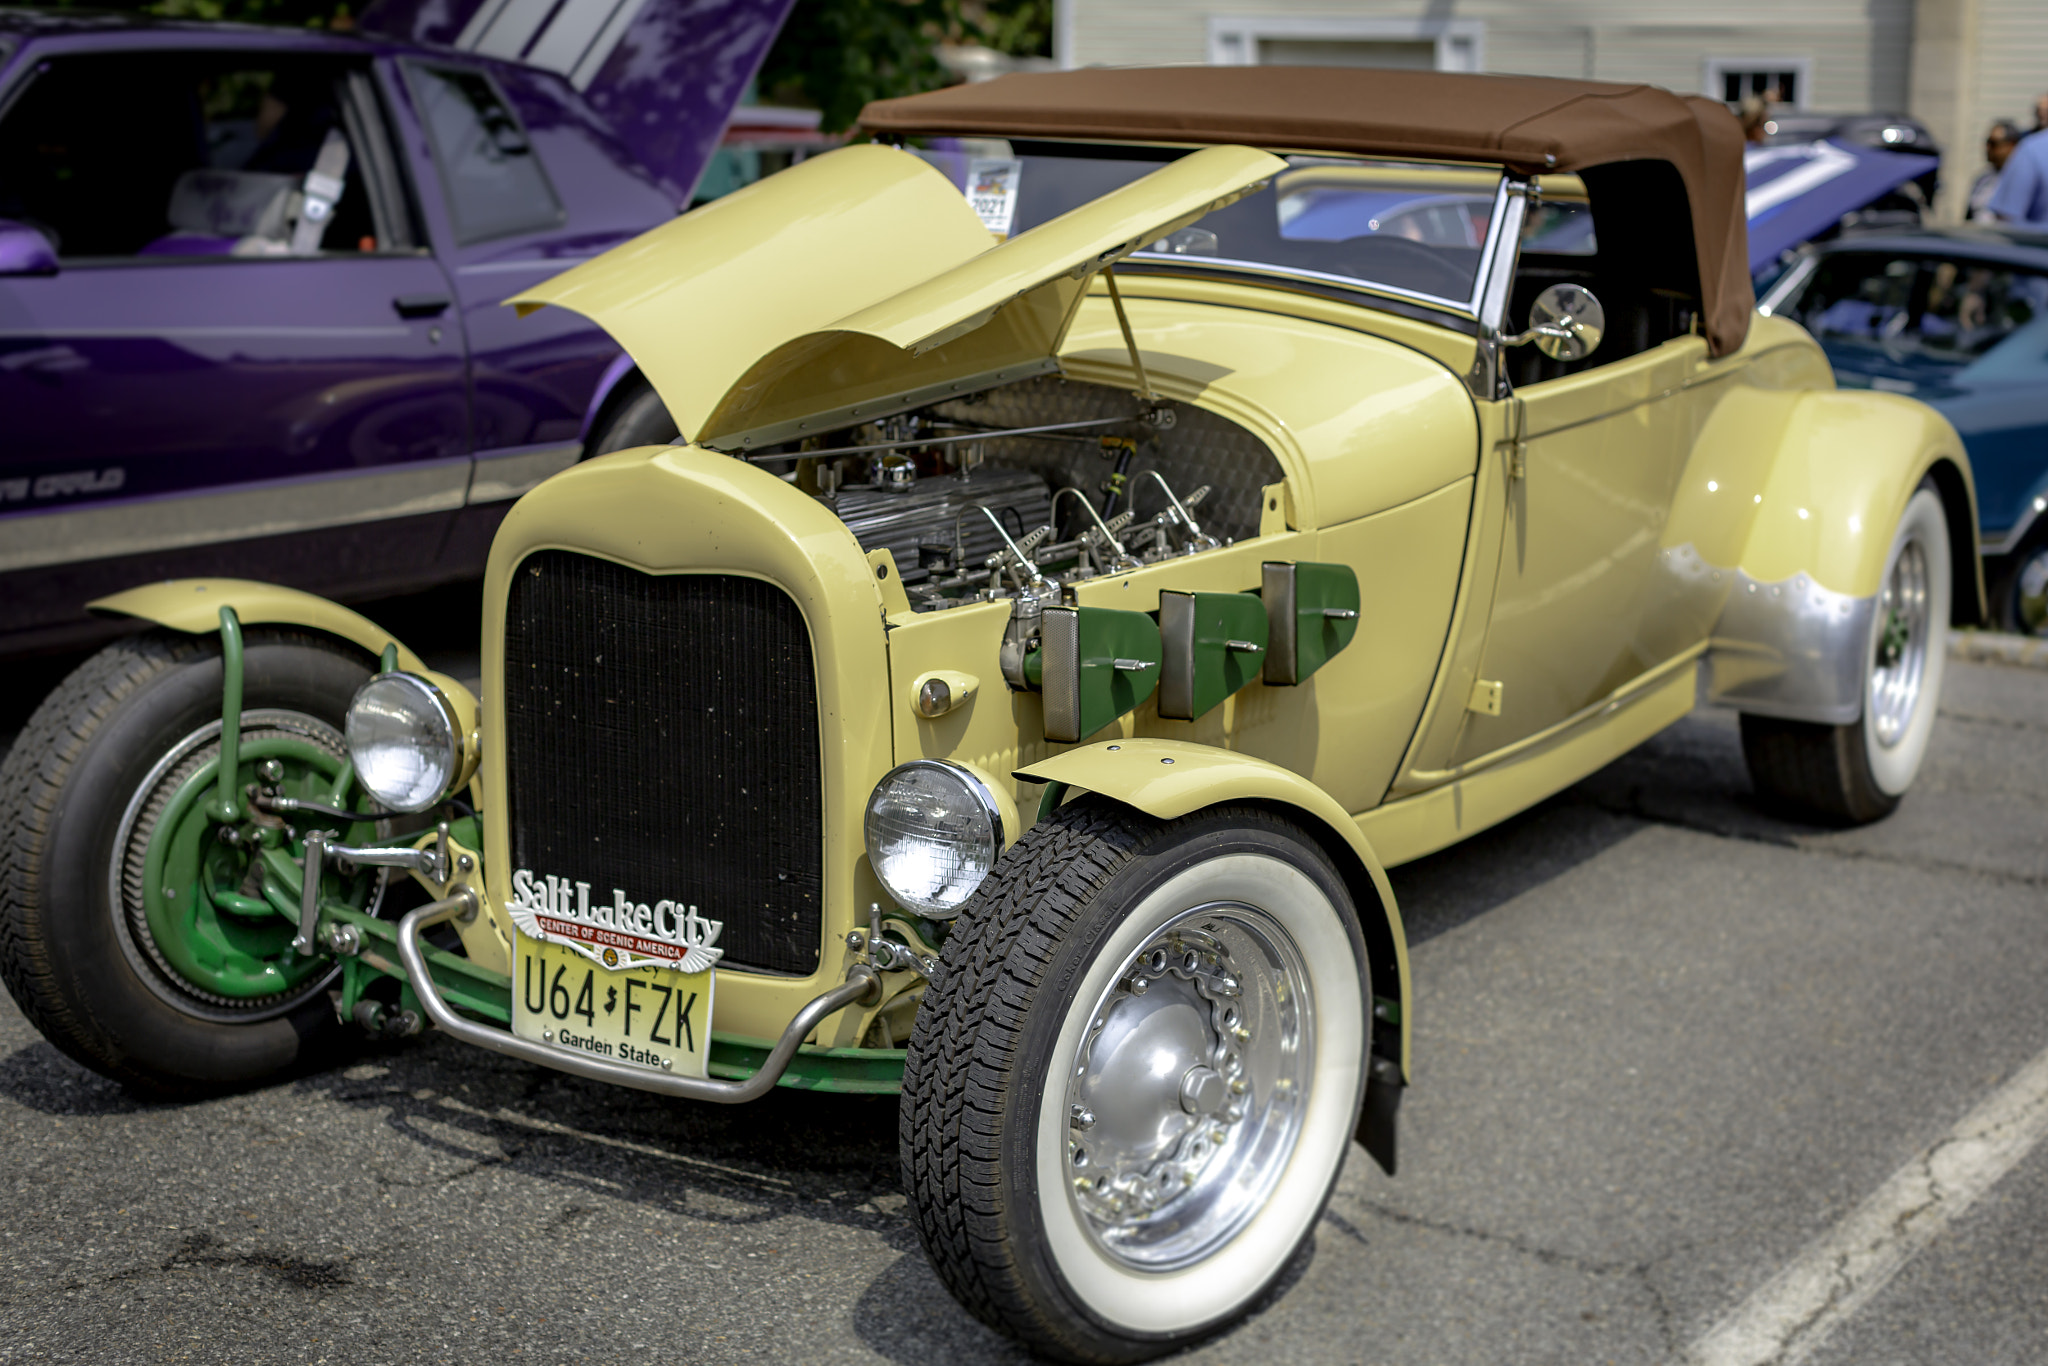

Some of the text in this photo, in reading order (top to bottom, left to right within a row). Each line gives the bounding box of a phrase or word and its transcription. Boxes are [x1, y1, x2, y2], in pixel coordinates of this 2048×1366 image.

[513, 869, 723, 948] Salt Lake City
[539, 917, 681, 959] CENTER OF SCENIC AMERICA
[1057, 902, 1120, 992] Coker Classic
[525, 954, 698, 1054] U64 FZK
[559, 1028, 660, 1067] Garden State
